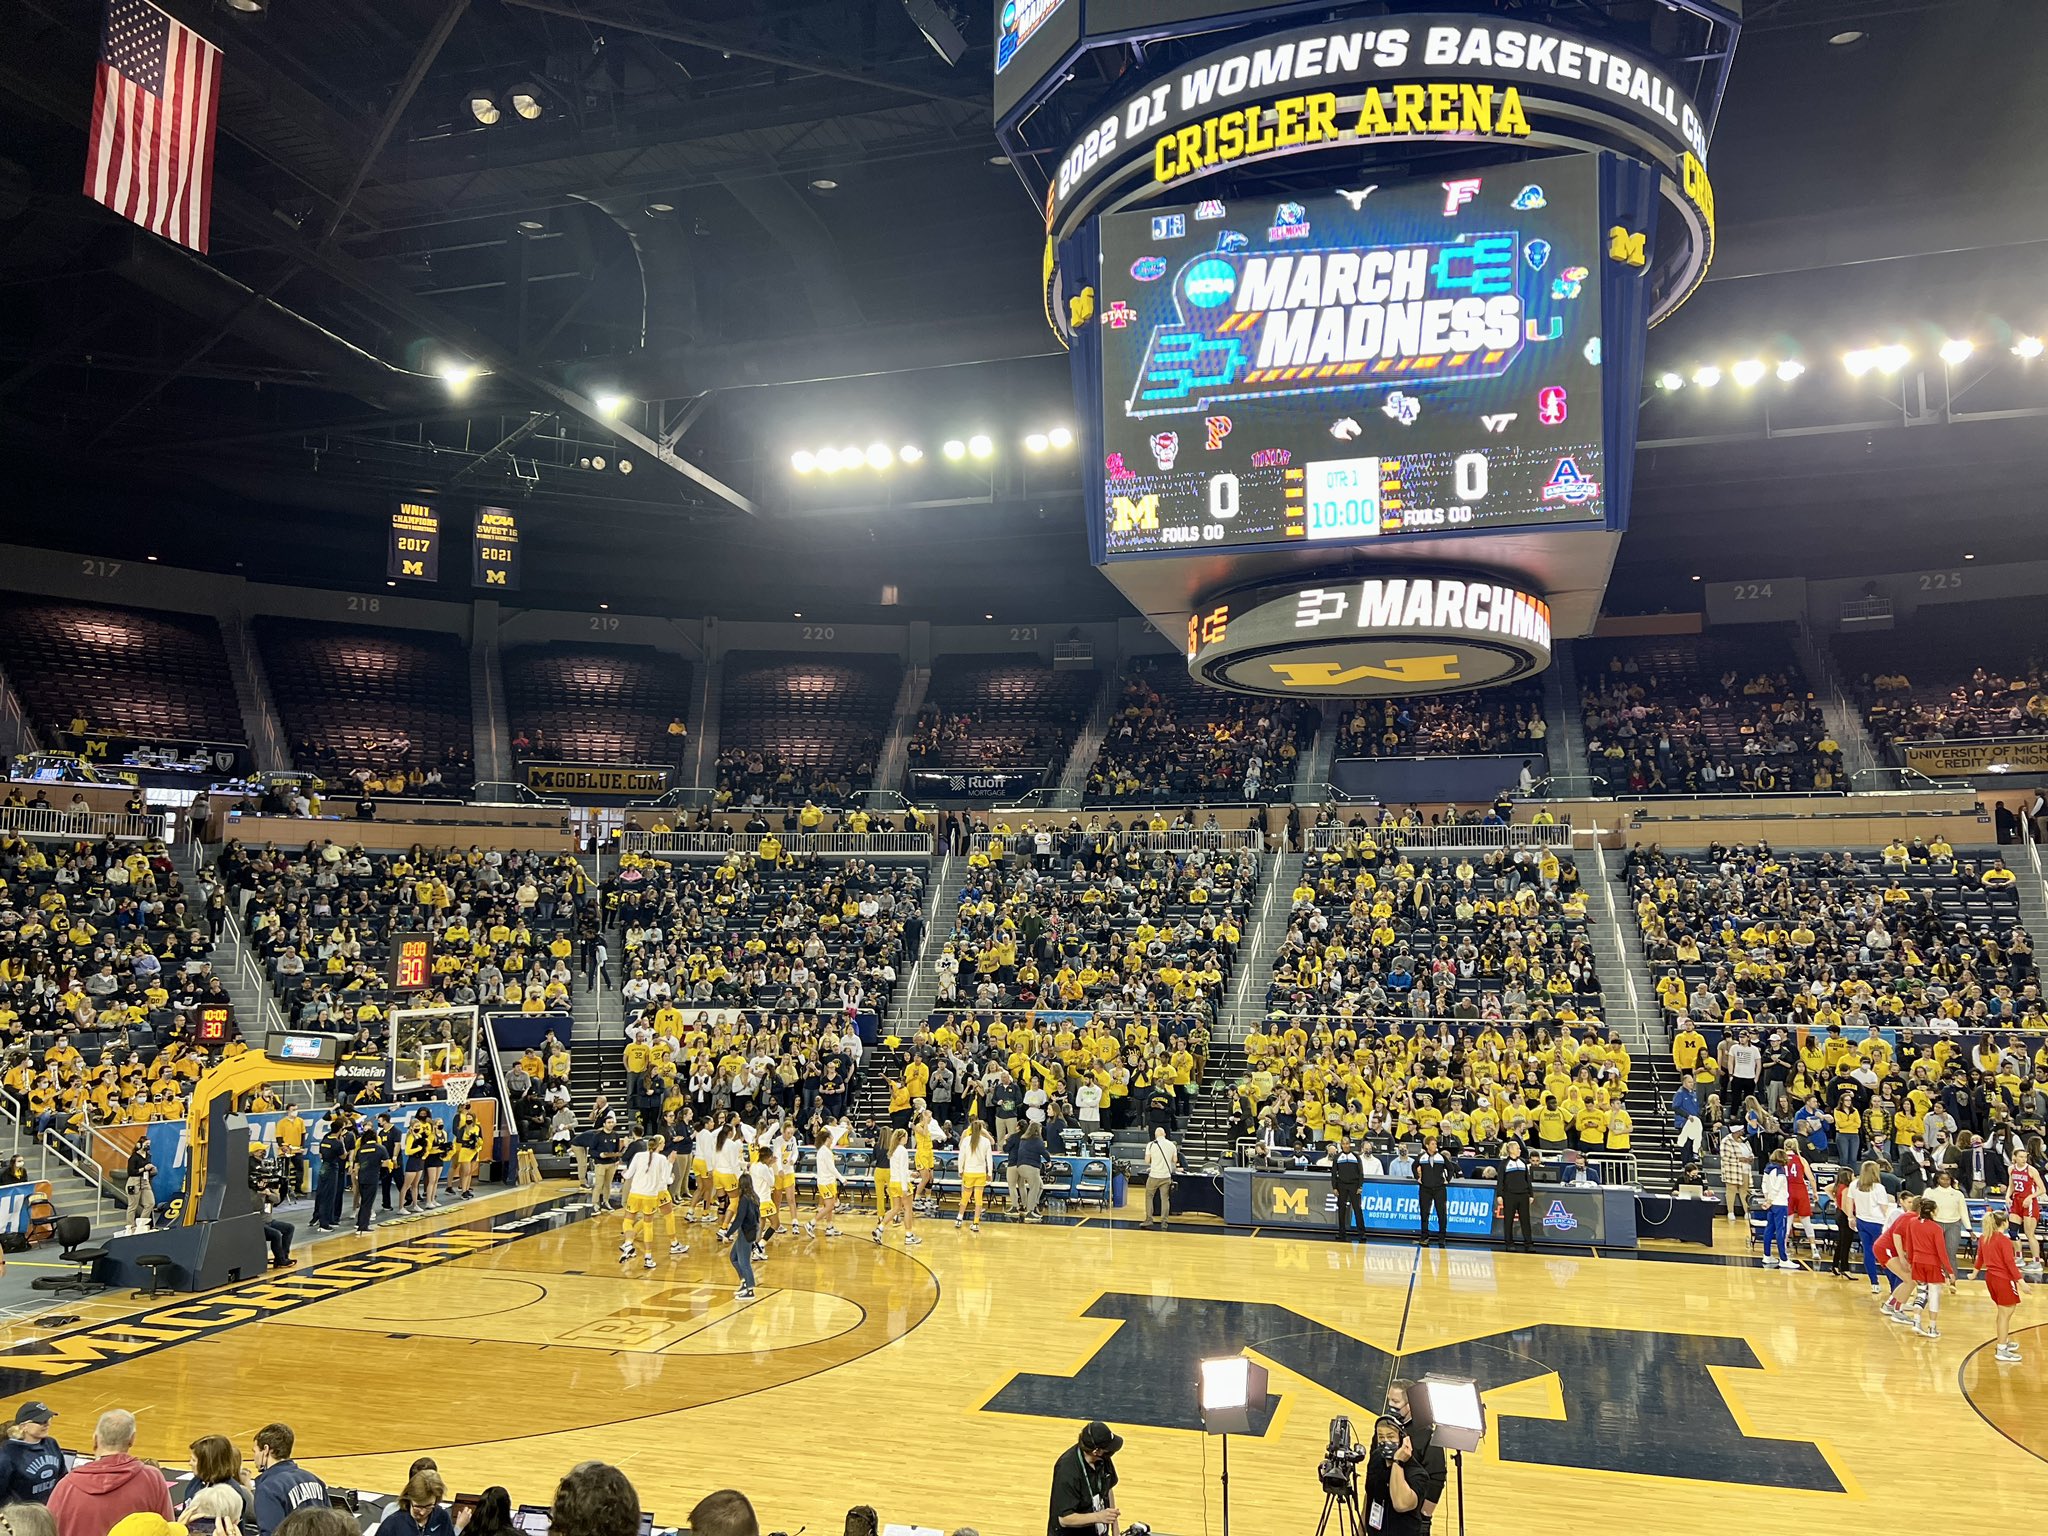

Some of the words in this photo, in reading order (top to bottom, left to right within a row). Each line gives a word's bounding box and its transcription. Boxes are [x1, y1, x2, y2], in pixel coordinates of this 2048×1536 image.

[1059, 115, 1119, 200] 2022
[1125, 82, 1171, 140] DI
[1180, 28, 1410, 113] WOMEN'S
[1424, 27, 1679, 126] BASKETBALL
[1154, 87, 1340, 183] CRISLER
[1355, 84, 1532, 137] ARENA
[1442, 177, 1482, 216] F
[1608, 226, 1647, 267] M
[1236, 249, 1429, 313] MARCH
[1070, 286, 1095, 328] M
[1101, 309, 1138, 324] STATE
[1257, 296, 1520, 368] MADNESS
[1481, 412, 1519, 433] VT
[1205, 416, 1233, 451] P
[1455, 453, 1489, 500] 0
[1210, 473, 1240, 519] 0
[401, 503, 430, 517] WNIT
[1112, 494, 1160, 532] M
[1312, 499, 1375, 529] 10:00
[1403, 508, 1446, 527] FOULS
[1448, 506, 1473, 524] 00
[392, 514, 438, 527] CHAMPIONS
[482, 514, 514, 527] NCAA
[477, 525, 508, 536] SWEET
[1162, 525, 1201, 544] FOULS
[1203, 524, 1225, 541] 00
[398, 537, 431, 552] 2017
[482, 547, 512, 562] 2021
[82, 560, 122, 577] 217
[402, 559, 424, 576] M
[486, 569, 506, 584] M
[1919, 572, 1962, 592] 225
[1734, 582, 1774, 601] 224
[347, 595, 381, 613] 218
[589, 615, 621, 632] 219
[802, 626, 835, 642] 220
[1010, 627, 1039, 642] 221
[85, 740, 108, 757] M
[1909, 747, 1988, 760] UNIVERSITY
[1992, 747, 2011, 756] OF
[1935, 757, 1984, 769] CREDIT
[968, 776, 1006, 788] Ruoff
[968, 789, 1006, 797] MORTGAGE
[402, 941, 427, 957] 10:00
[400, 958, 423, 986] 30
[204, 1009, 227, 1021] 10:00
[206, 1023, 222, 1039] 30
[1684, 1040, 1696, 1048] M
[1903, 1047, 1915, 1056] M
[2013, 1181, 2024, 1192] 23
[164, 1198, 183, 1219] GO
[1272, 1186, 1309, 1215] M
[1369, 1211, 1389, 1219] HOSTED
[1543, 1216, 1578, 1228] AMERICAN
[0, 1229, 523, 1376] MICHIGAN
